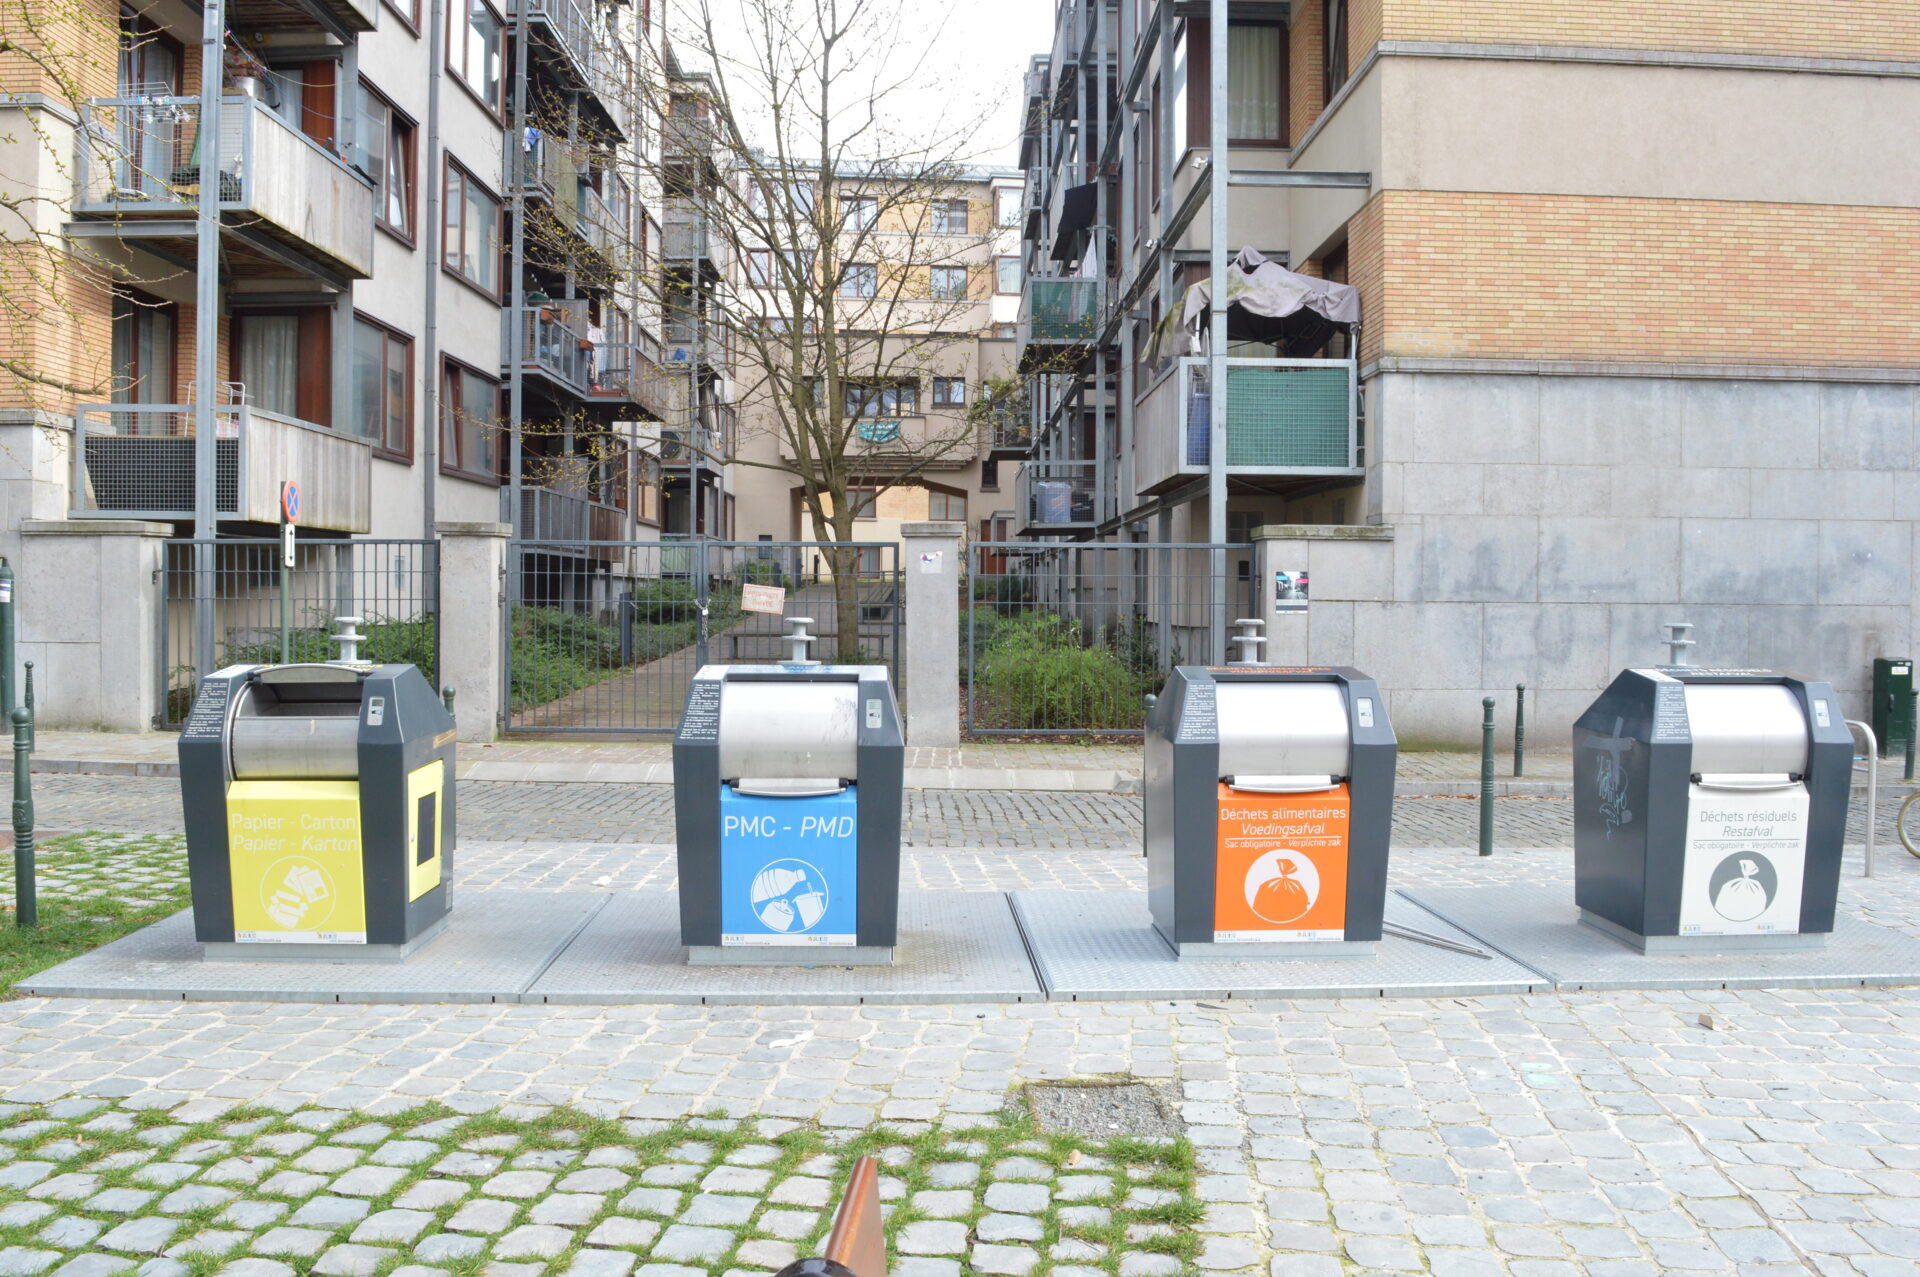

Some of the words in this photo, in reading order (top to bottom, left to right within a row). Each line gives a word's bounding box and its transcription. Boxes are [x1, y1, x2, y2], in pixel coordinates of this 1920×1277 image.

[1221, 808, 1269, 820] Déchets
[1271, 807, 1347, 819] alimentaires
[1700, 810, 1744, 822] Déchets
[1747, 810, 1798, 822] résiduels
[231, 813, 286, 833] Papier
[300, 814, 356, 830] Carton
[724, 815, 777, 838] PMC
[799, 816, 855, 838] PMD
[1241, 822, 1326, 838] Voedingsafval
[1722, 825, 1774, 837] Restafval
[232, 834, 287, 854] Papier
[301, 835, 358, 851] Karton
[1224, 840, 1239, 848] Sac
[1240, 839, 1281, 849] obligatoire
[1288, 839, 1327, 848] Verplichte
[1327, 839, 1342, 847] zak
[1693, 841, 1706, 850] Sac
[1707, 841, 1745, 850] obligatoire
[1751, 841, 1787, 850] Verplichte
